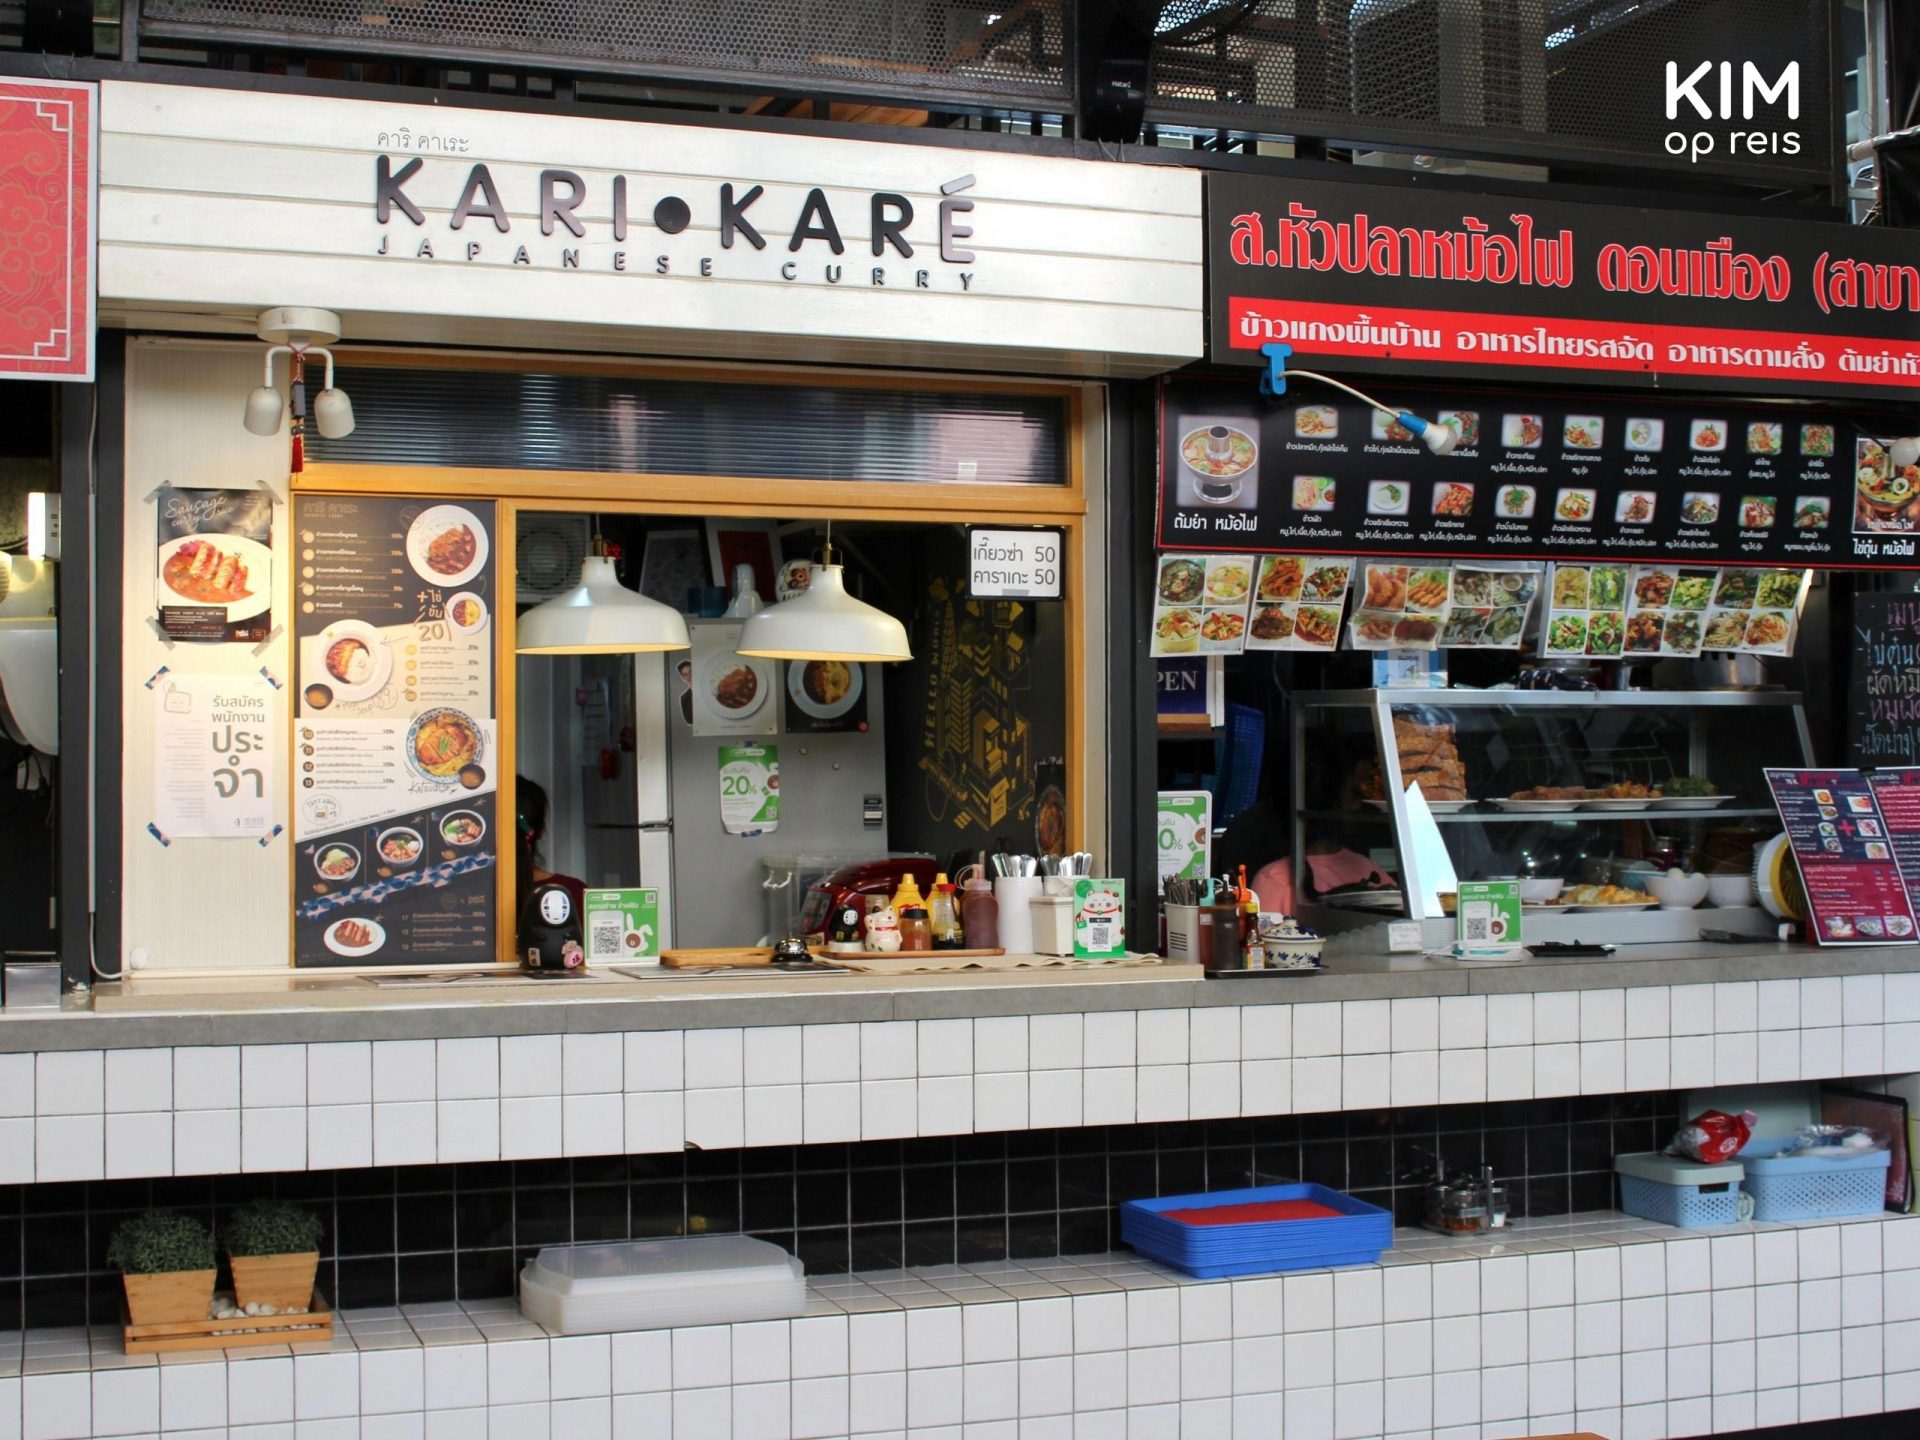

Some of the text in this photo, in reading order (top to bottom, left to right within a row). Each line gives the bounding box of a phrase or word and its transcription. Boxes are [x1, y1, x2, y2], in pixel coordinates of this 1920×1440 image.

[378, 127, 469, 152] คาริ คาเระ
[376, 154, 977, 265] KARI KARÉ
[377, 234, 974, 291] JAPANESE CURRY
[1230, 202, 1574, 288] ส.หัวปลาหม้อไฟ
[1597, 237, 1791, 302] ดอนเมือง
[1240, 311, 1920, 376] ข้าวแกงพื้นบ้าน อาหารไทยรสจัด อาหารตามสั่ง ต้มยำหั
[165, 497, 227, 521] Sausage
[1174, 513, 1258, 532] ต้มยำ หม้อไฟ
[1034, 546, 1056, 563] 50
[1882, 539, 1914, 556] หม้อไฟ
[974, 569, 1055, 585] คาราเกะ 50
[418, 623, 444, 642] 20
[1157, 671, 1198, 691] PEN
[212, 695, 264, 708] รับสมัคร
[211, 710, 265, 723] พนักงาน
[212, 725, 264, 753] ประ
[212, 755, 264, 798] จำ
[722, 775, 757, 796] 20%
[1158, 828, 1184, 850] 0%
